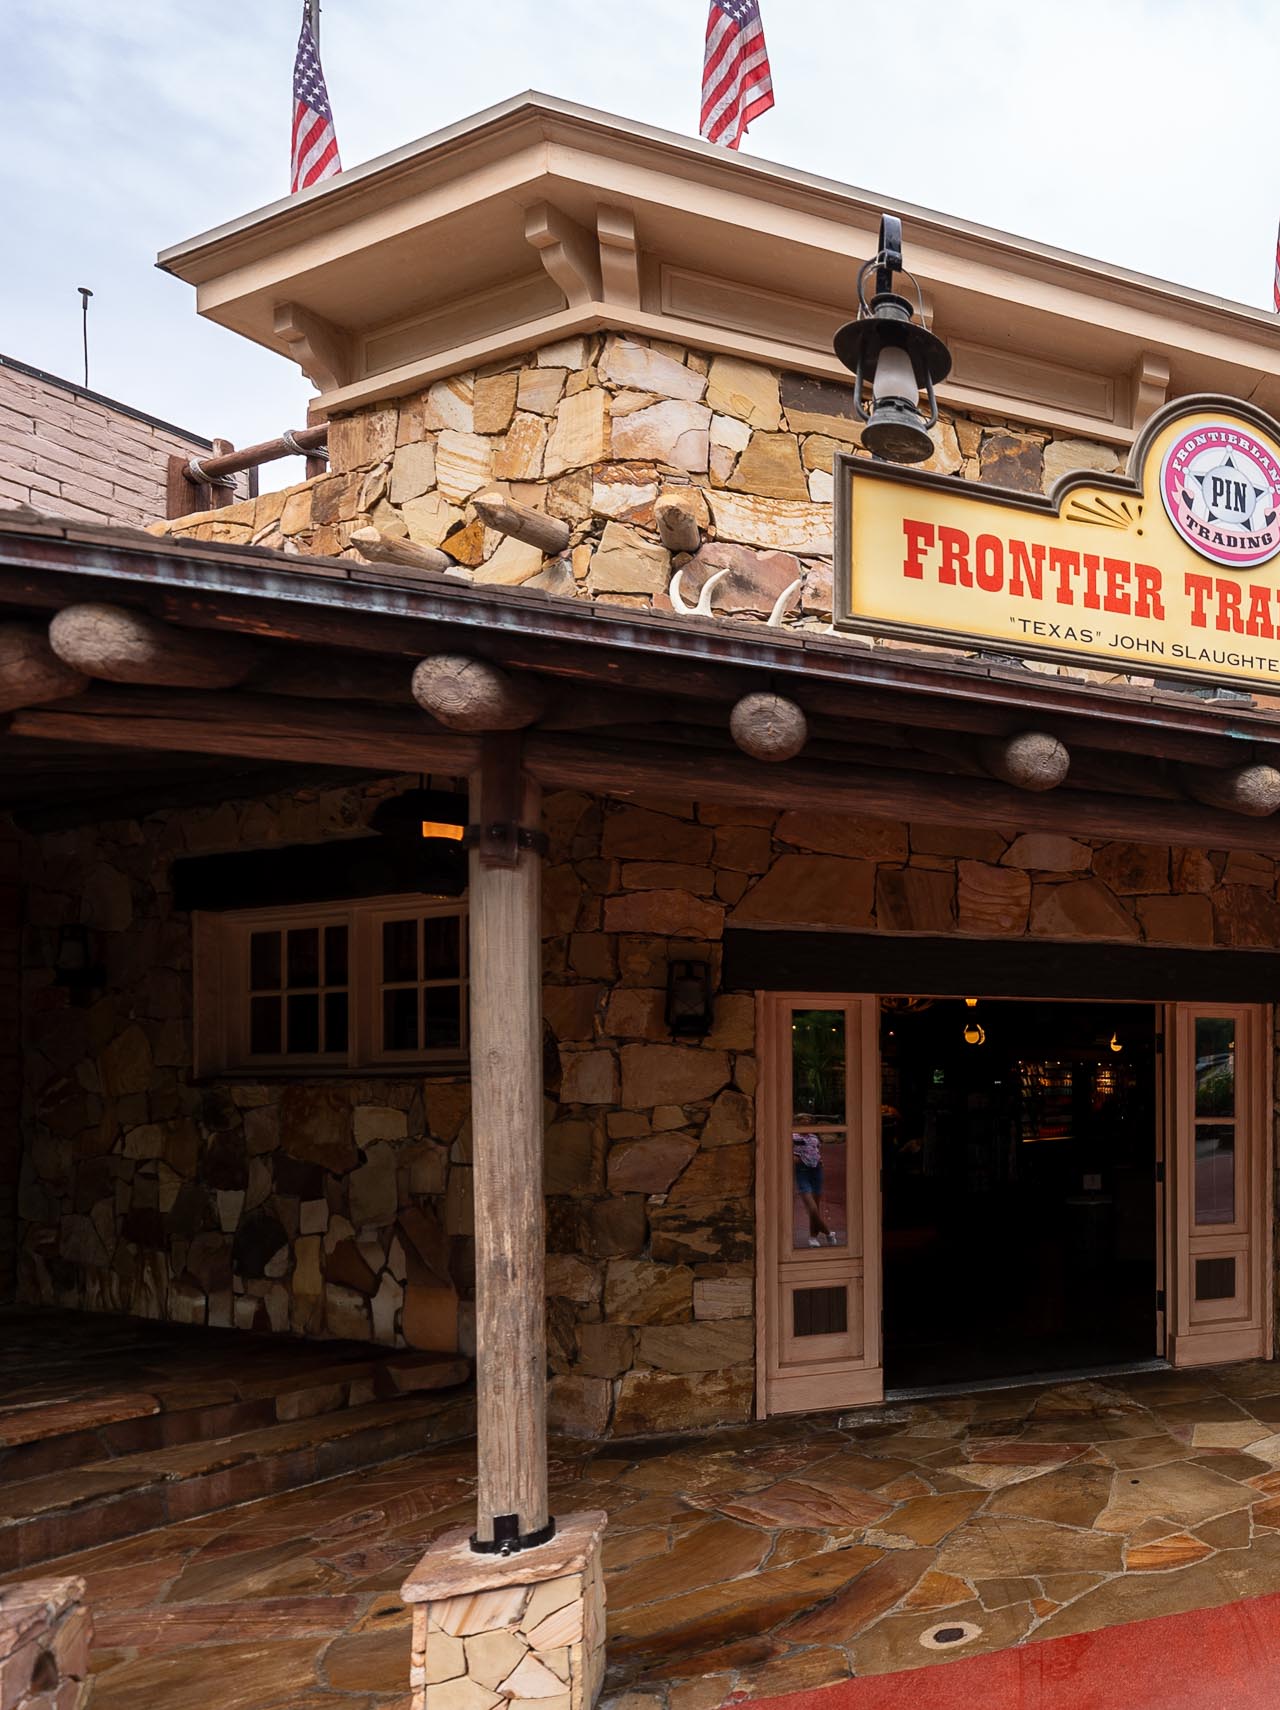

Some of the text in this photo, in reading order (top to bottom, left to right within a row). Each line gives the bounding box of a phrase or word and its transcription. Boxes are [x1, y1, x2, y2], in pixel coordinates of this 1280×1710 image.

[1212, 476, 1248, 514] PIN
[1186, 514, 1273, 549] TRADING
[903, 518, 1165, 621] FRONTIER
[1109, 634, 1165, 655] JOHN
